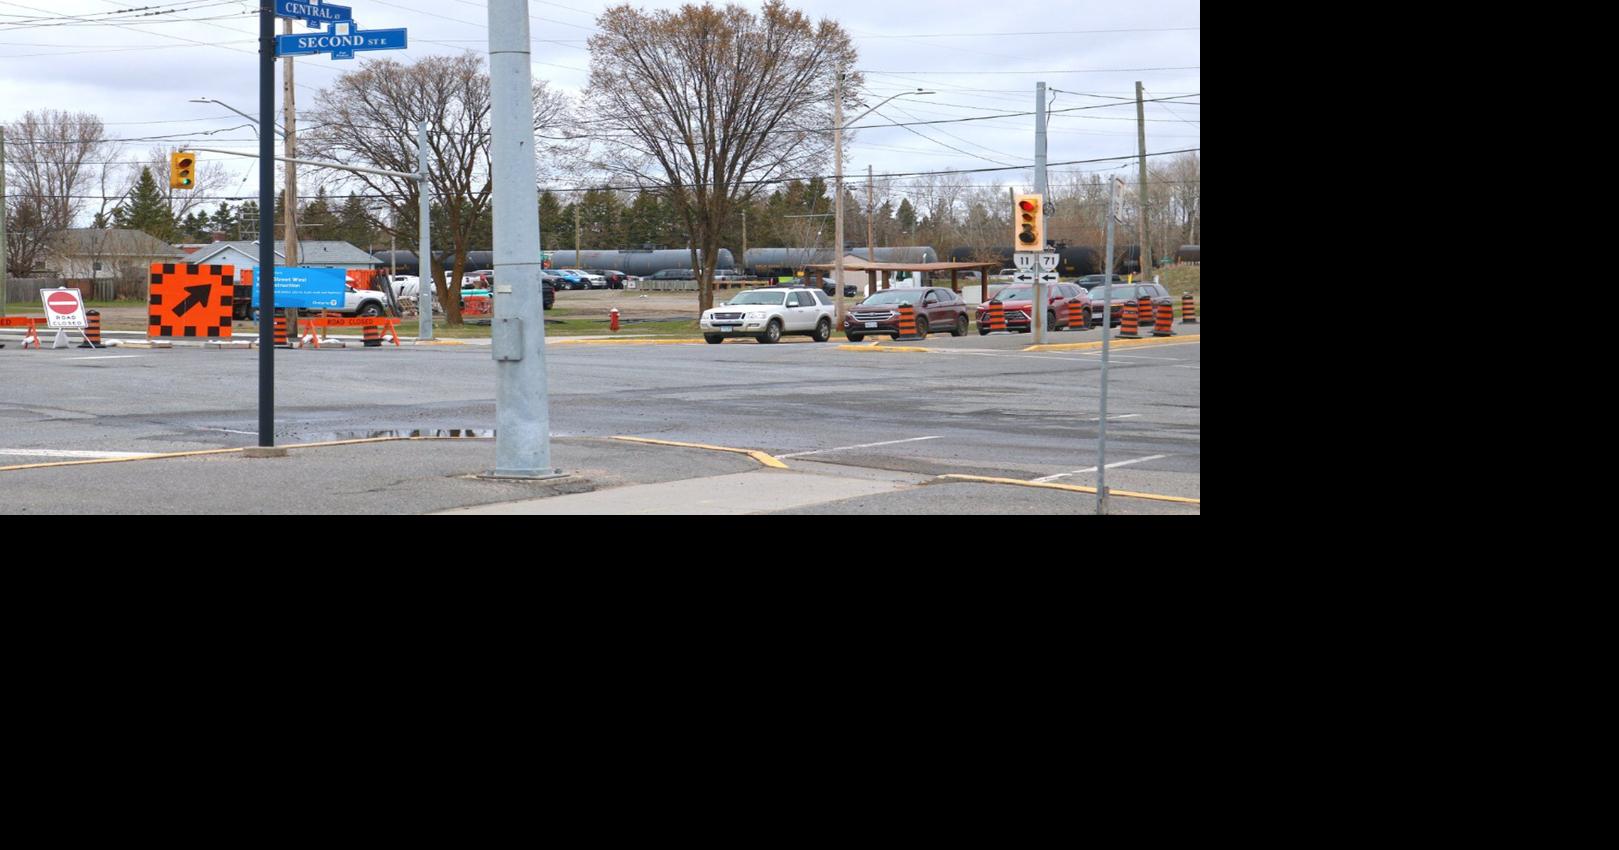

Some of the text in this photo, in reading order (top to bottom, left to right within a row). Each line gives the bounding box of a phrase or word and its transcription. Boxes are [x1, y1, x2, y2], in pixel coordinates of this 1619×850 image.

[285, 2, 333, 19] CENTRAL
[298, 35, 364, 48] SECOND
[1020, 256, 1029, 265] 11
[1043, 256, 1055, 265] 71
